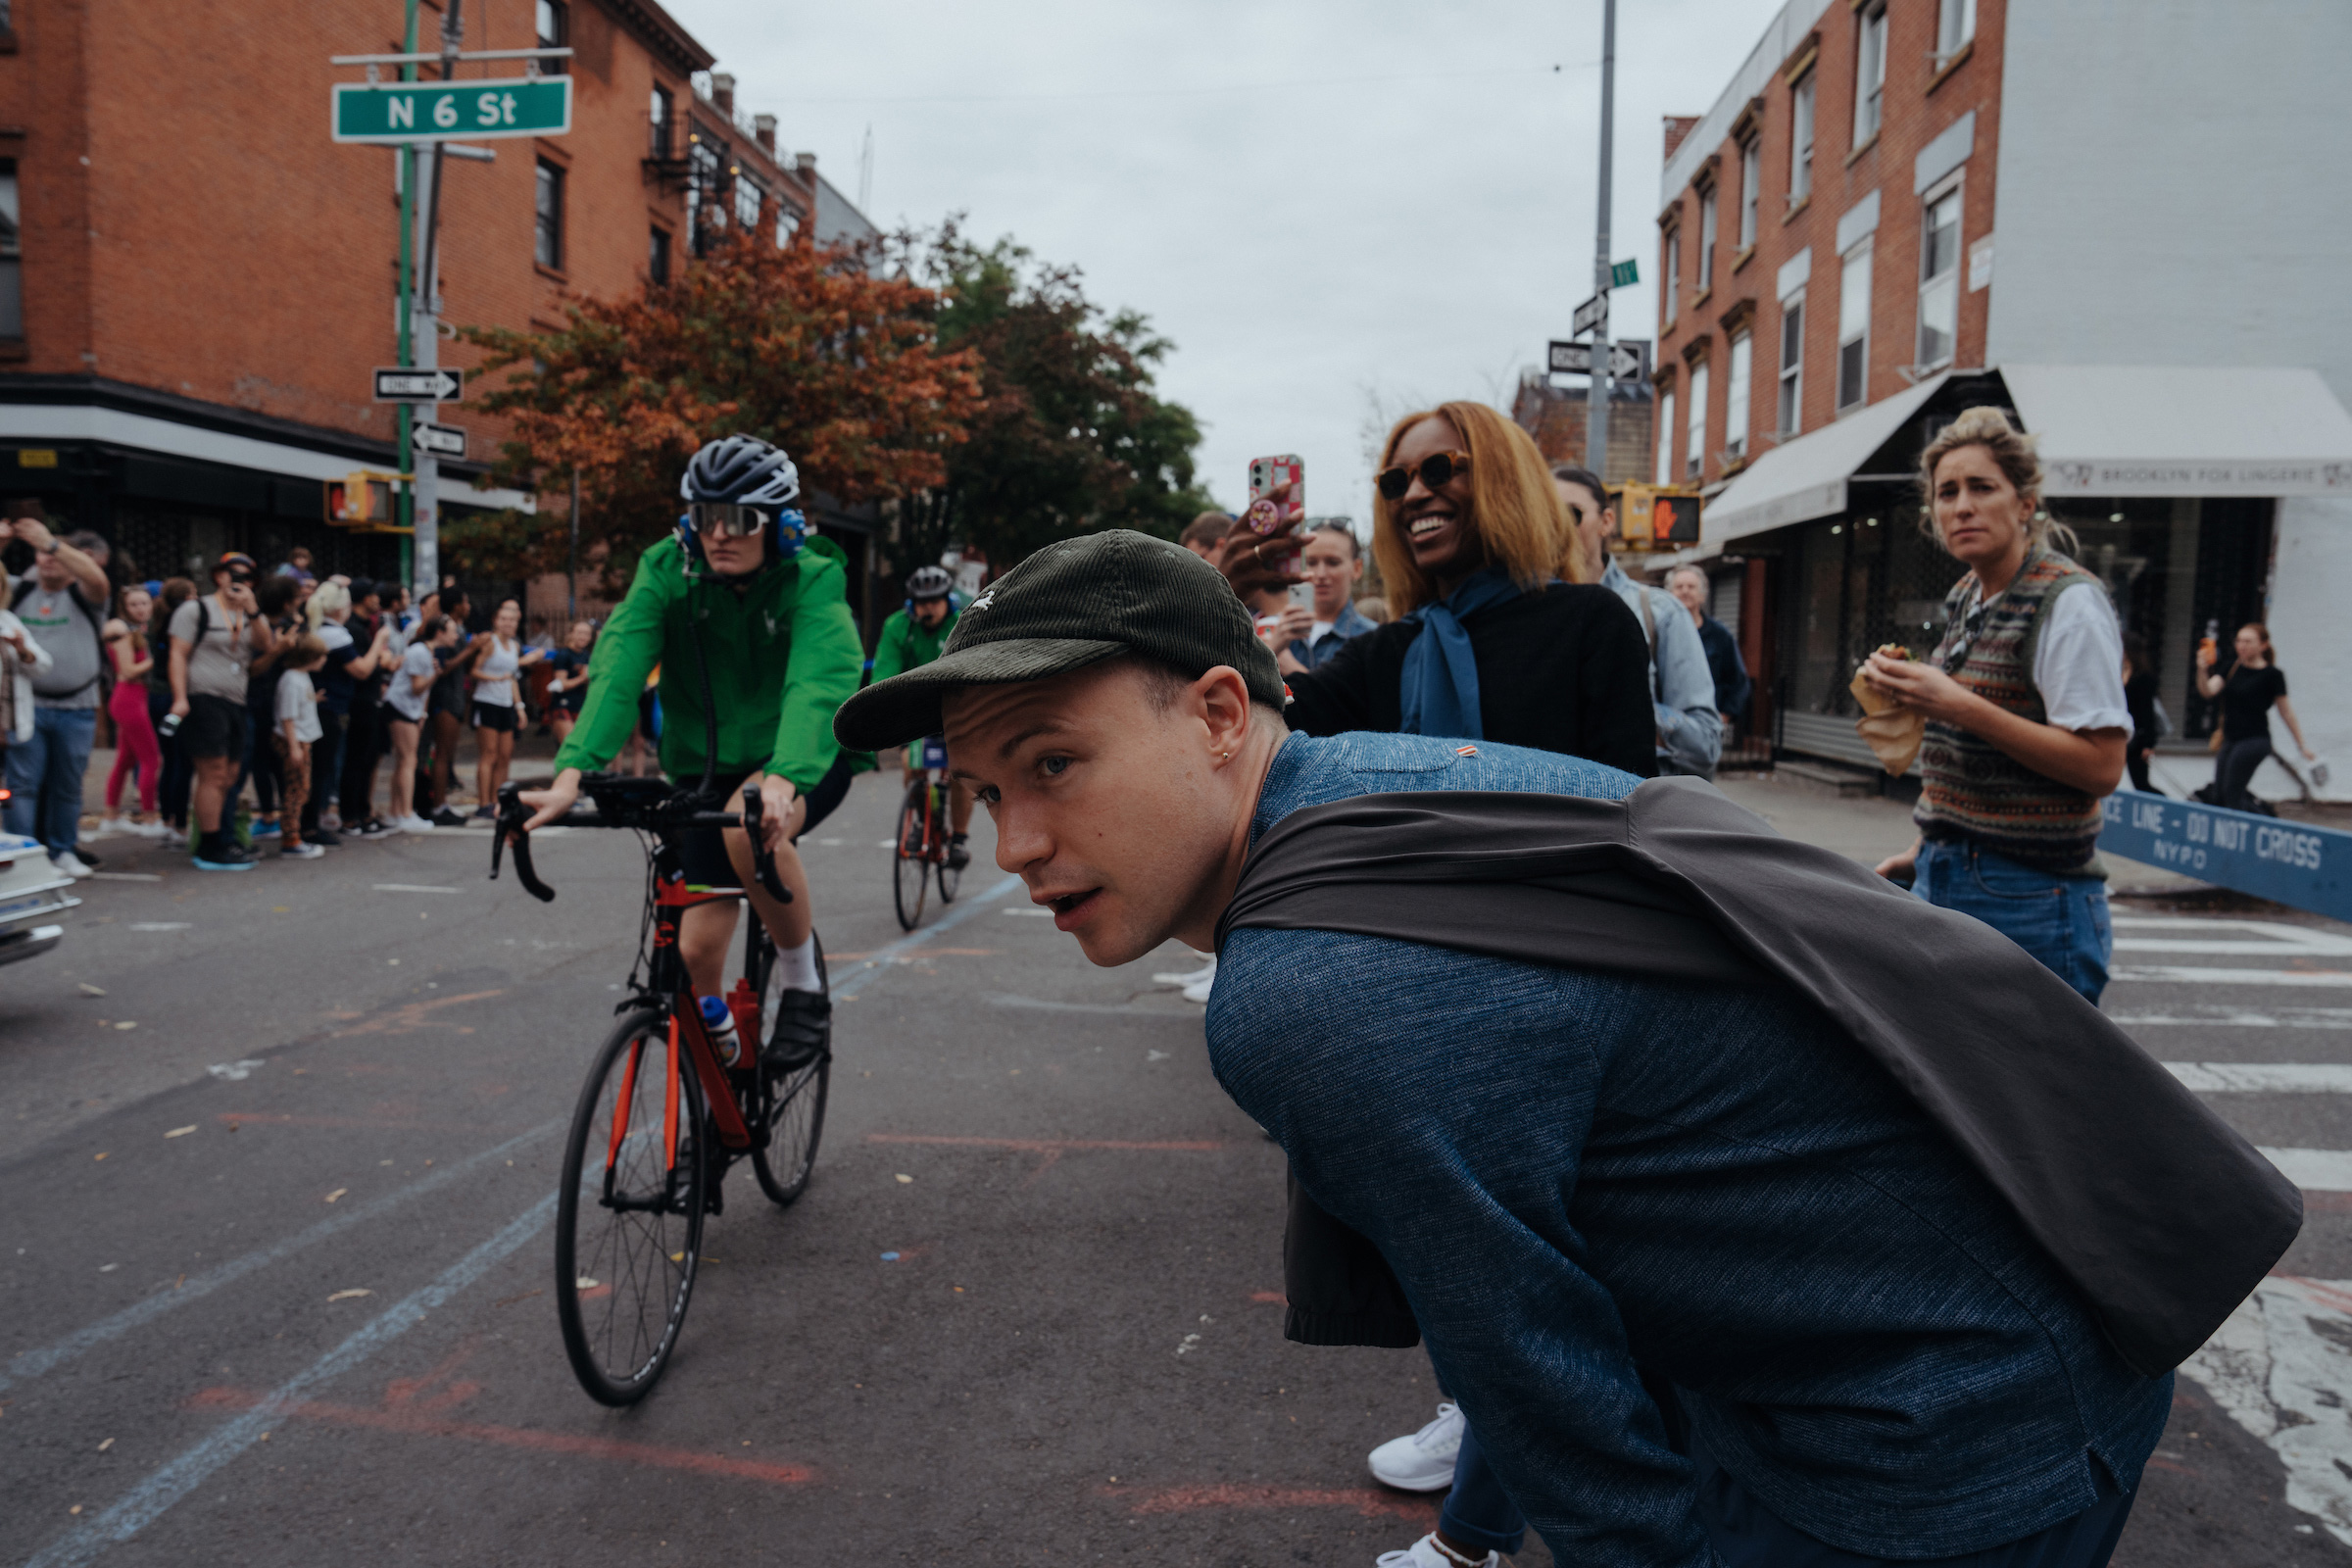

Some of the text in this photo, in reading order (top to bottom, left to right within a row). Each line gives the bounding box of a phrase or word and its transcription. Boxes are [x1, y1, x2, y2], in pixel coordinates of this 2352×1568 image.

[388, 92, 517, 129] N 6 St
[388, 377, 411, 391] ONE
[2101, 467, 2192, 483] BROOKLYN
[2238, 467, 2315, 483] LINGERIE
[2132, 801, 2165, 833] LINE
[2186, 811, 2209, 844] DO
[2214, 817, 2250, 853] NOT
[2256, 825, 2322, 870] CROSS
